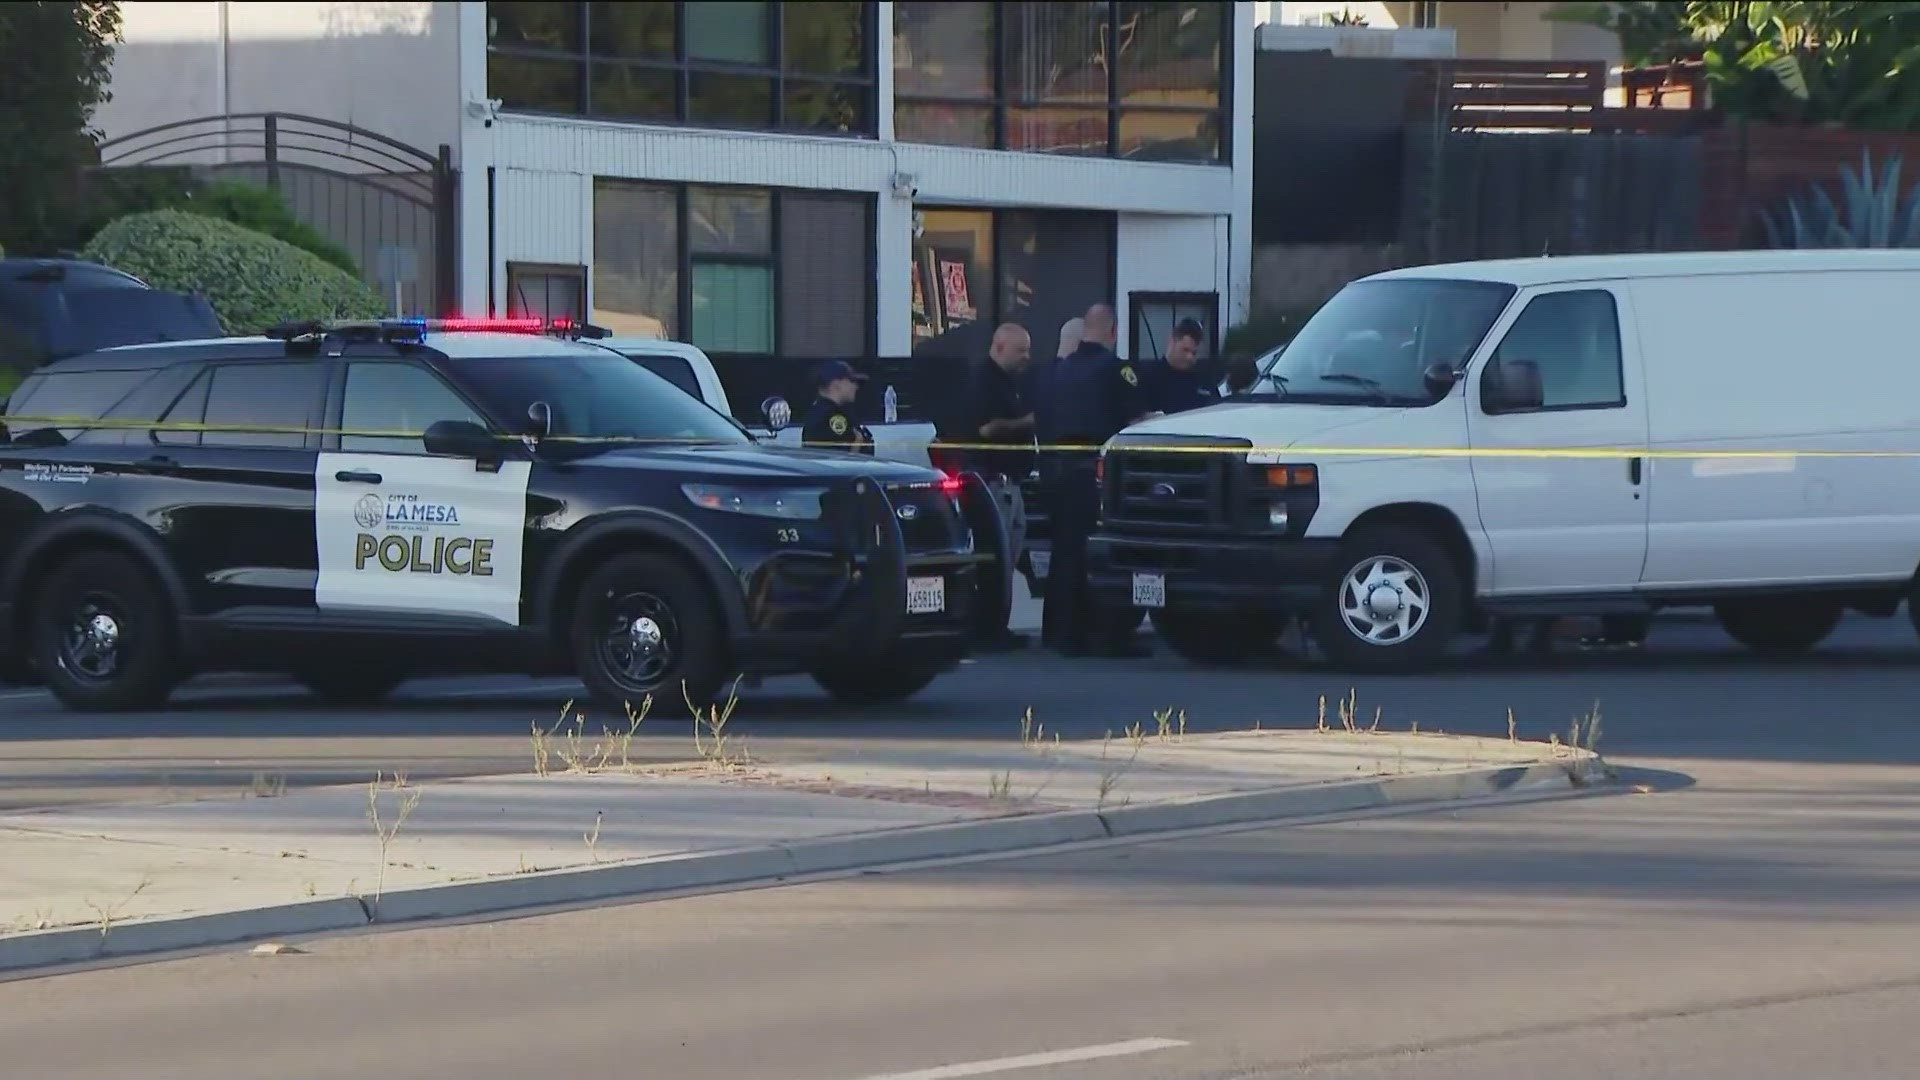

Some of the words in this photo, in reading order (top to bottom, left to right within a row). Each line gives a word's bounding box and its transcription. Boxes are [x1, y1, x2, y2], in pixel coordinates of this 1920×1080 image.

[386, 503, 408, 520] LA
[411, 504, 458, 522] MESA
[777, 529, 799, 543] 33
[355, 533, 494, 576] POLICE
